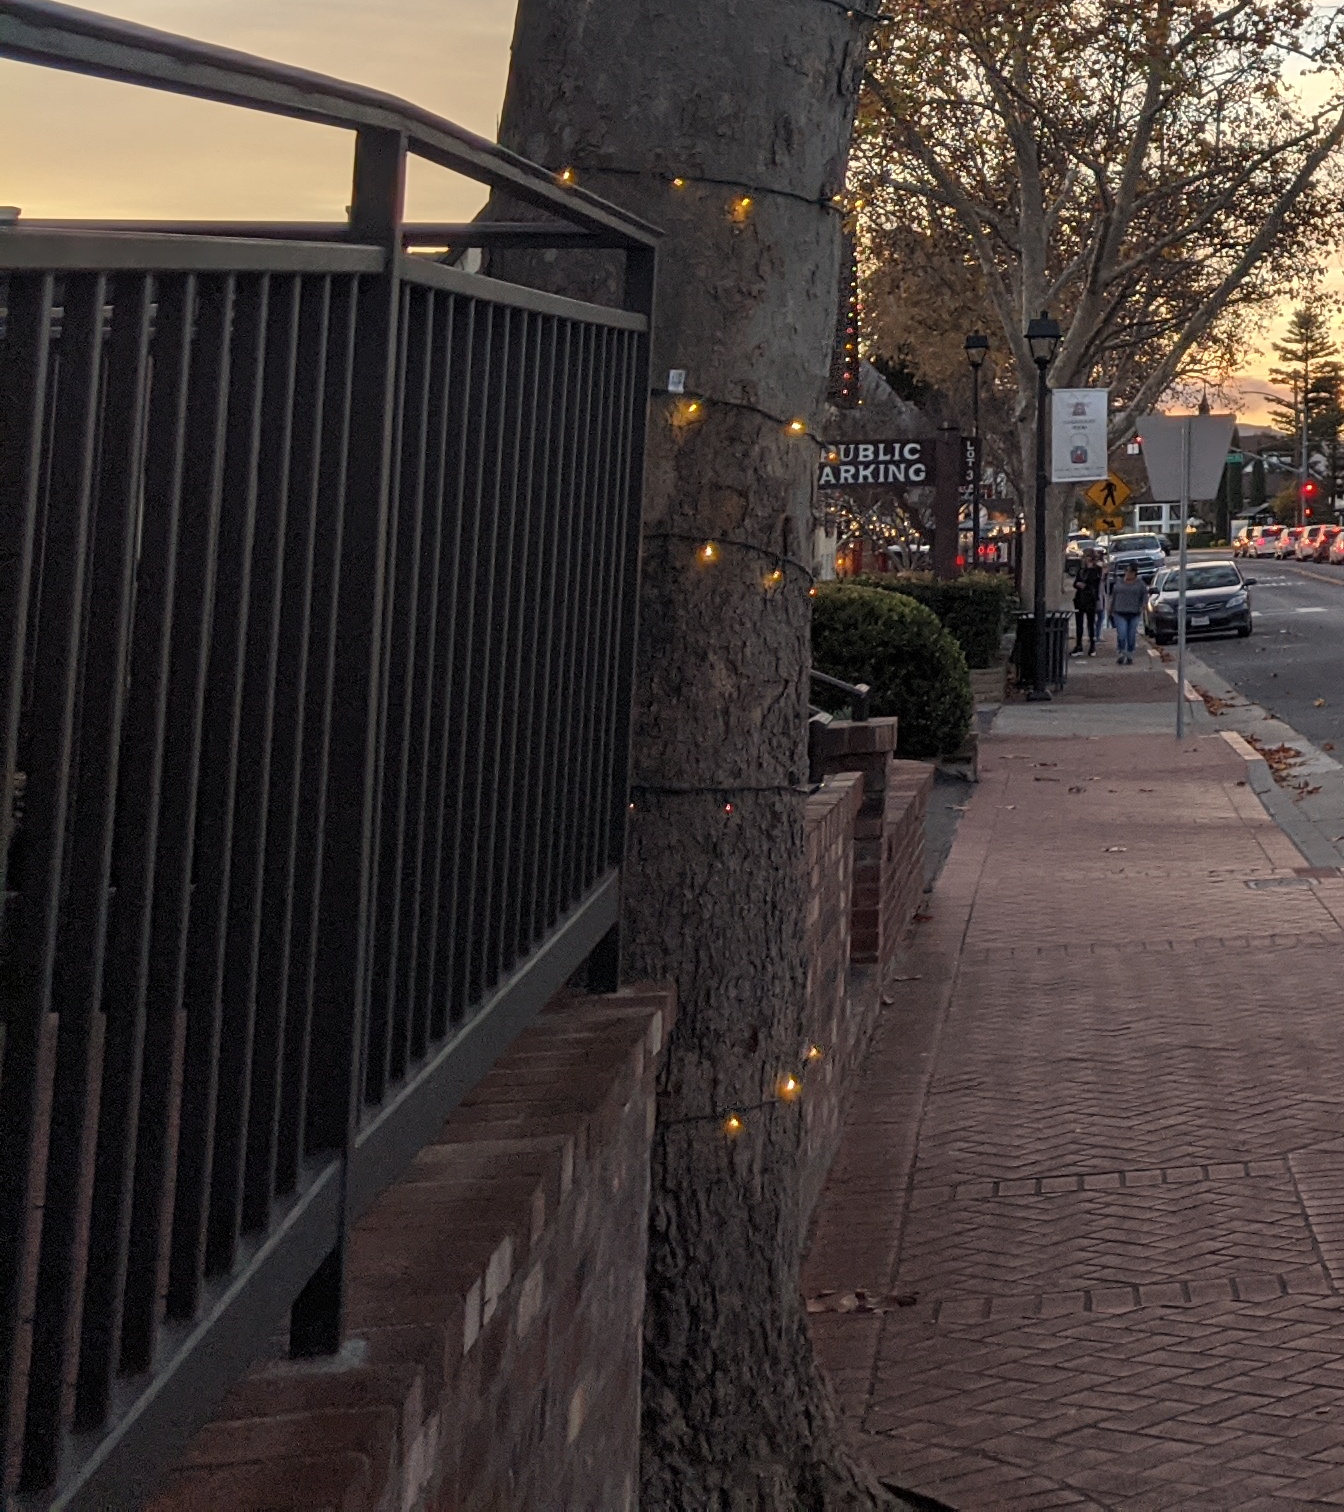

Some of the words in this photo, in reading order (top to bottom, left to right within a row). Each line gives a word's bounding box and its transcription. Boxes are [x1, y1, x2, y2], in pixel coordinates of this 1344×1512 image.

[966, 441, 975, 466] LOT
[819, 463, 927, 484] ARKING
[965, 470, 974, 481] 3
